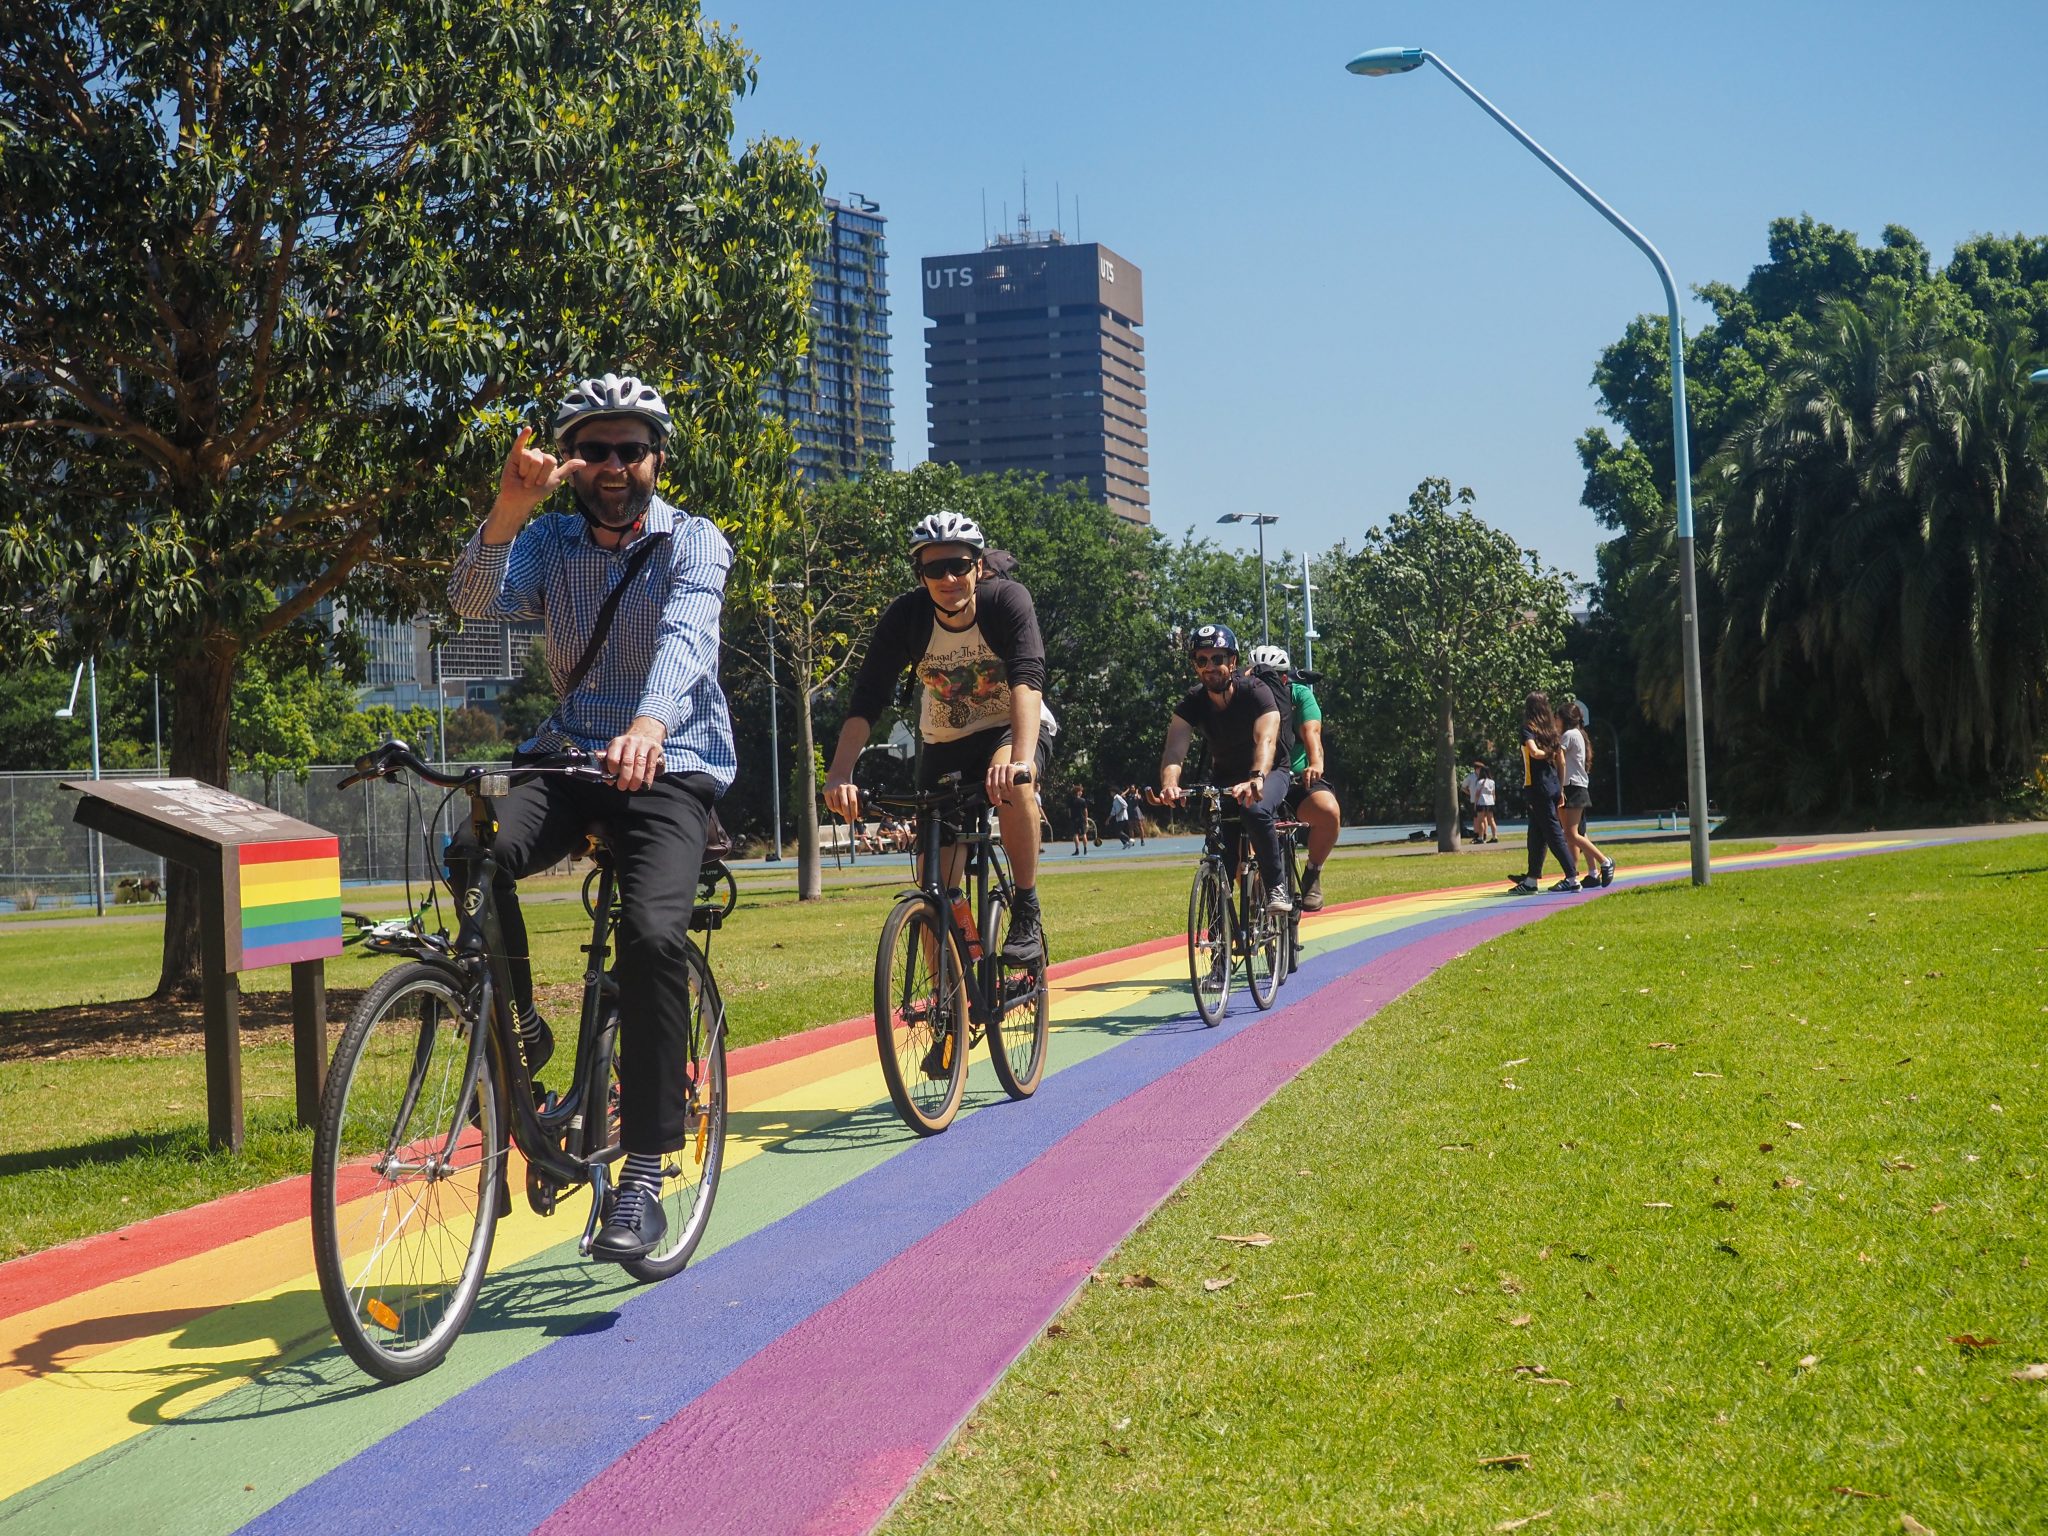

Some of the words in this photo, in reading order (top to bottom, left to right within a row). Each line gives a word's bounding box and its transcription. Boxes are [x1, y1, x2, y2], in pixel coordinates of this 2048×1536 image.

[926, 267, 974, 289] UTS
[1100, 257, 1115, 284] UTS
[958, 645, 977, 659] The
